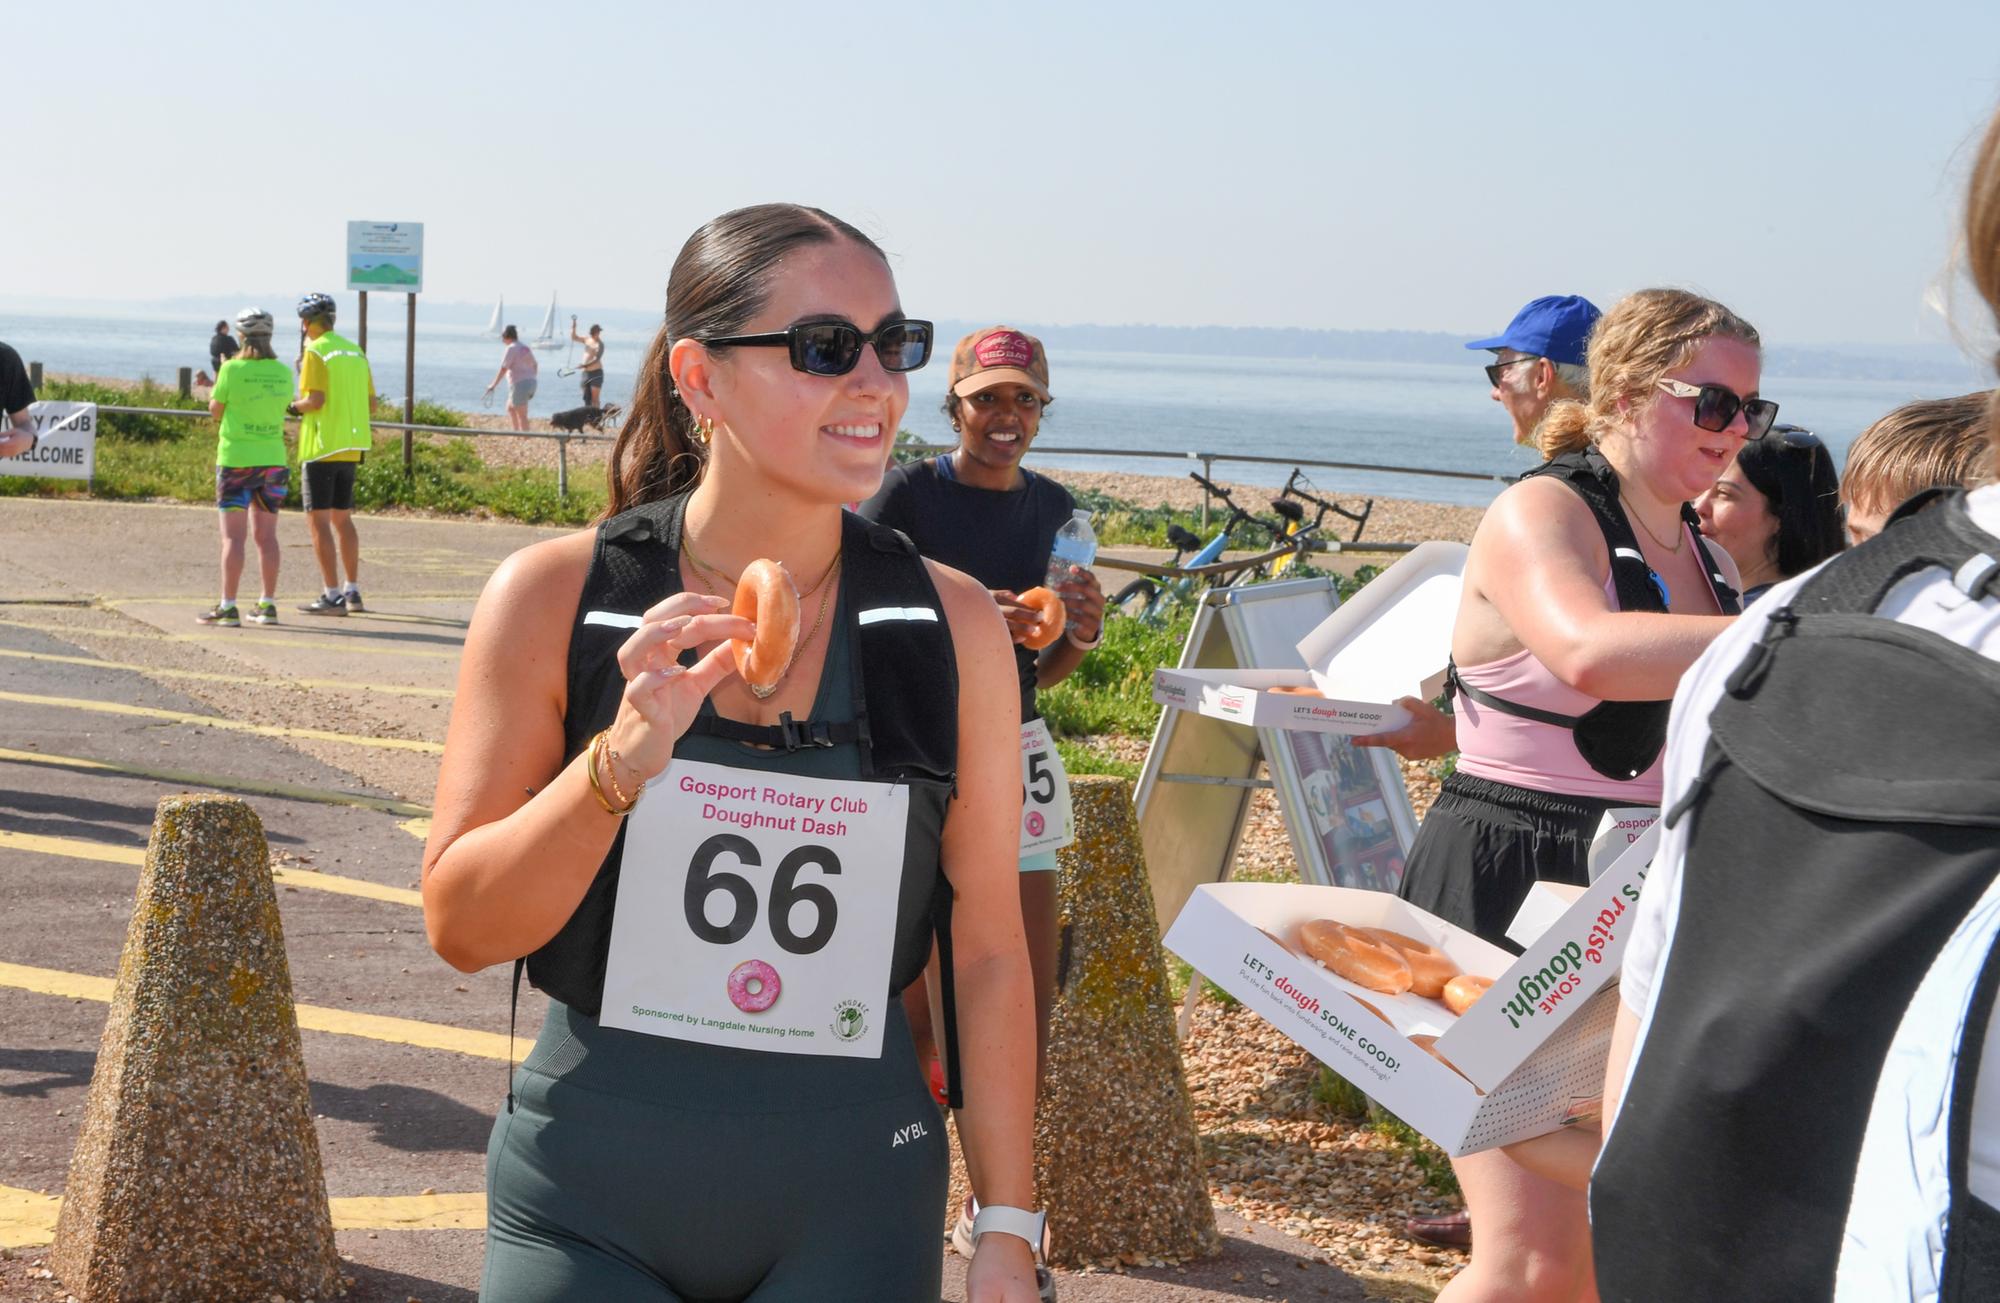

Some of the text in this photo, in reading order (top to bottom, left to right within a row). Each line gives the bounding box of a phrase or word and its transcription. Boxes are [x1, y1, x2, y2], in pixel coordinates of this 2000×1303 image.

[1293, 706, 1311, 714] LET'S
[1312, 706, 1337, 718] dough
[1338, 711, 1358, 719] SOME
[679, 776, 868, 814] Gosport Rotary Club
[1023, 751, 1055, 804] 5
[702, 803, 847, 836] Doughnut Dash
[684, 833, 842, 955] 66
[1586, 896, 1626, 964] raise
[1501, 941, 1582, 1029] dough!
[1538, 973, 1581, 1015] SOME
[632, 1005, 684, 1022] Sponsored
[686, 1012, 699, 1025] by
[701, 1016, 746, 1031] Langdale
[749, 1024, 786, 1037] Nursing
[788, 1028, 815, 1038] Home
[1243, 953, 1400, 1073] LET'S dough SOME GOOD!
[892, 1121, 928, 1148] AYBL
